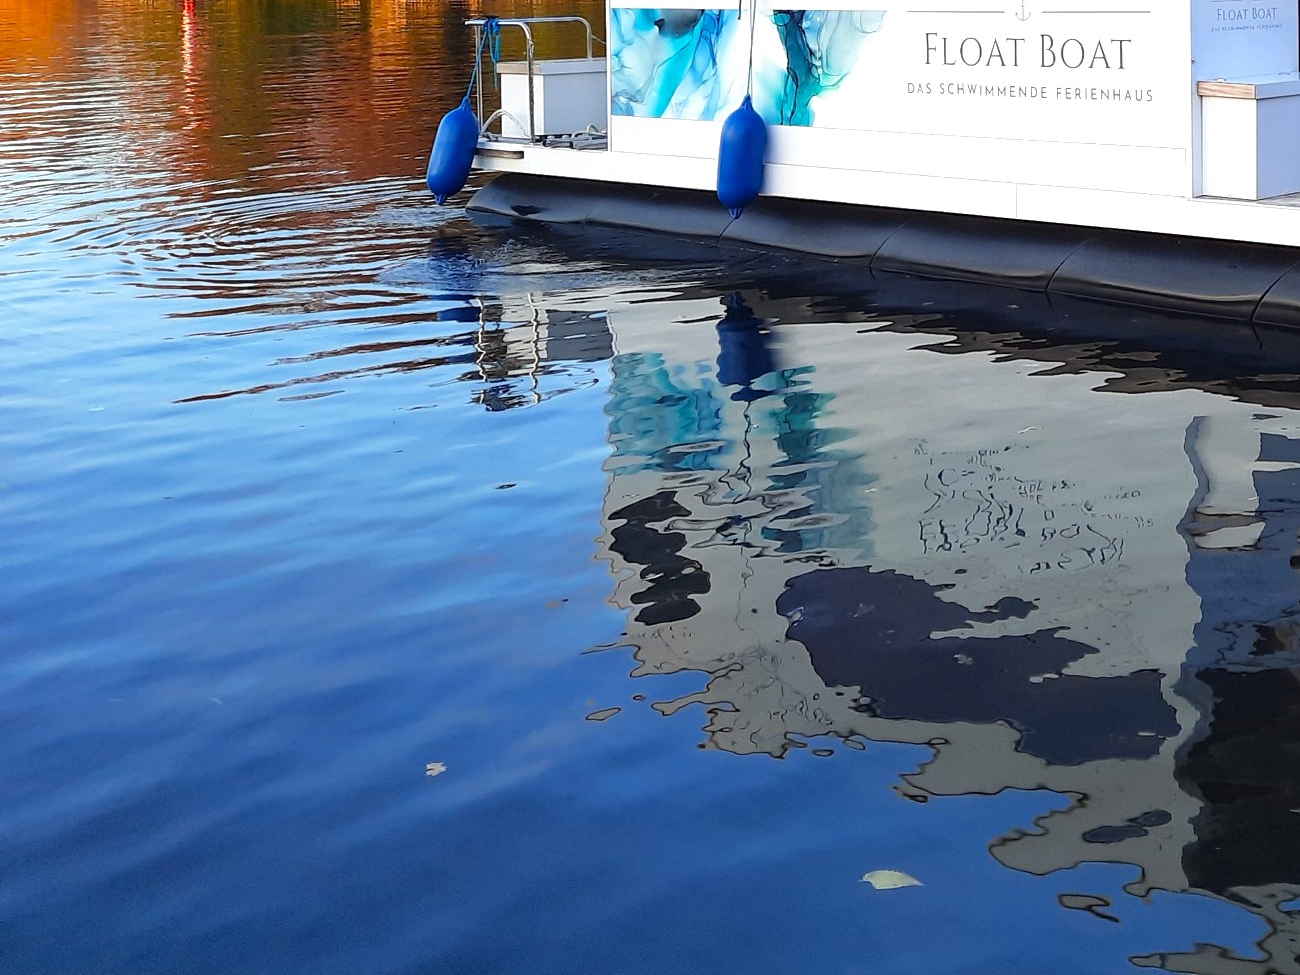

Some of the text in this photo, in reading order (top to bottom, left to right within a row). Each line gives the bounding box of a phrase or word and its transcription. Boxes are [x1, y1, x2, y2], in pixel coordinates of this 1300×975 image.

[1216, 7, 1278, 21] FLOAT BOAT
[924, 32, 1132, 70] FLOAT BOAT
[907, 82, 1153, 102] DAS SCHWIMMENDE FERIENHAUS
